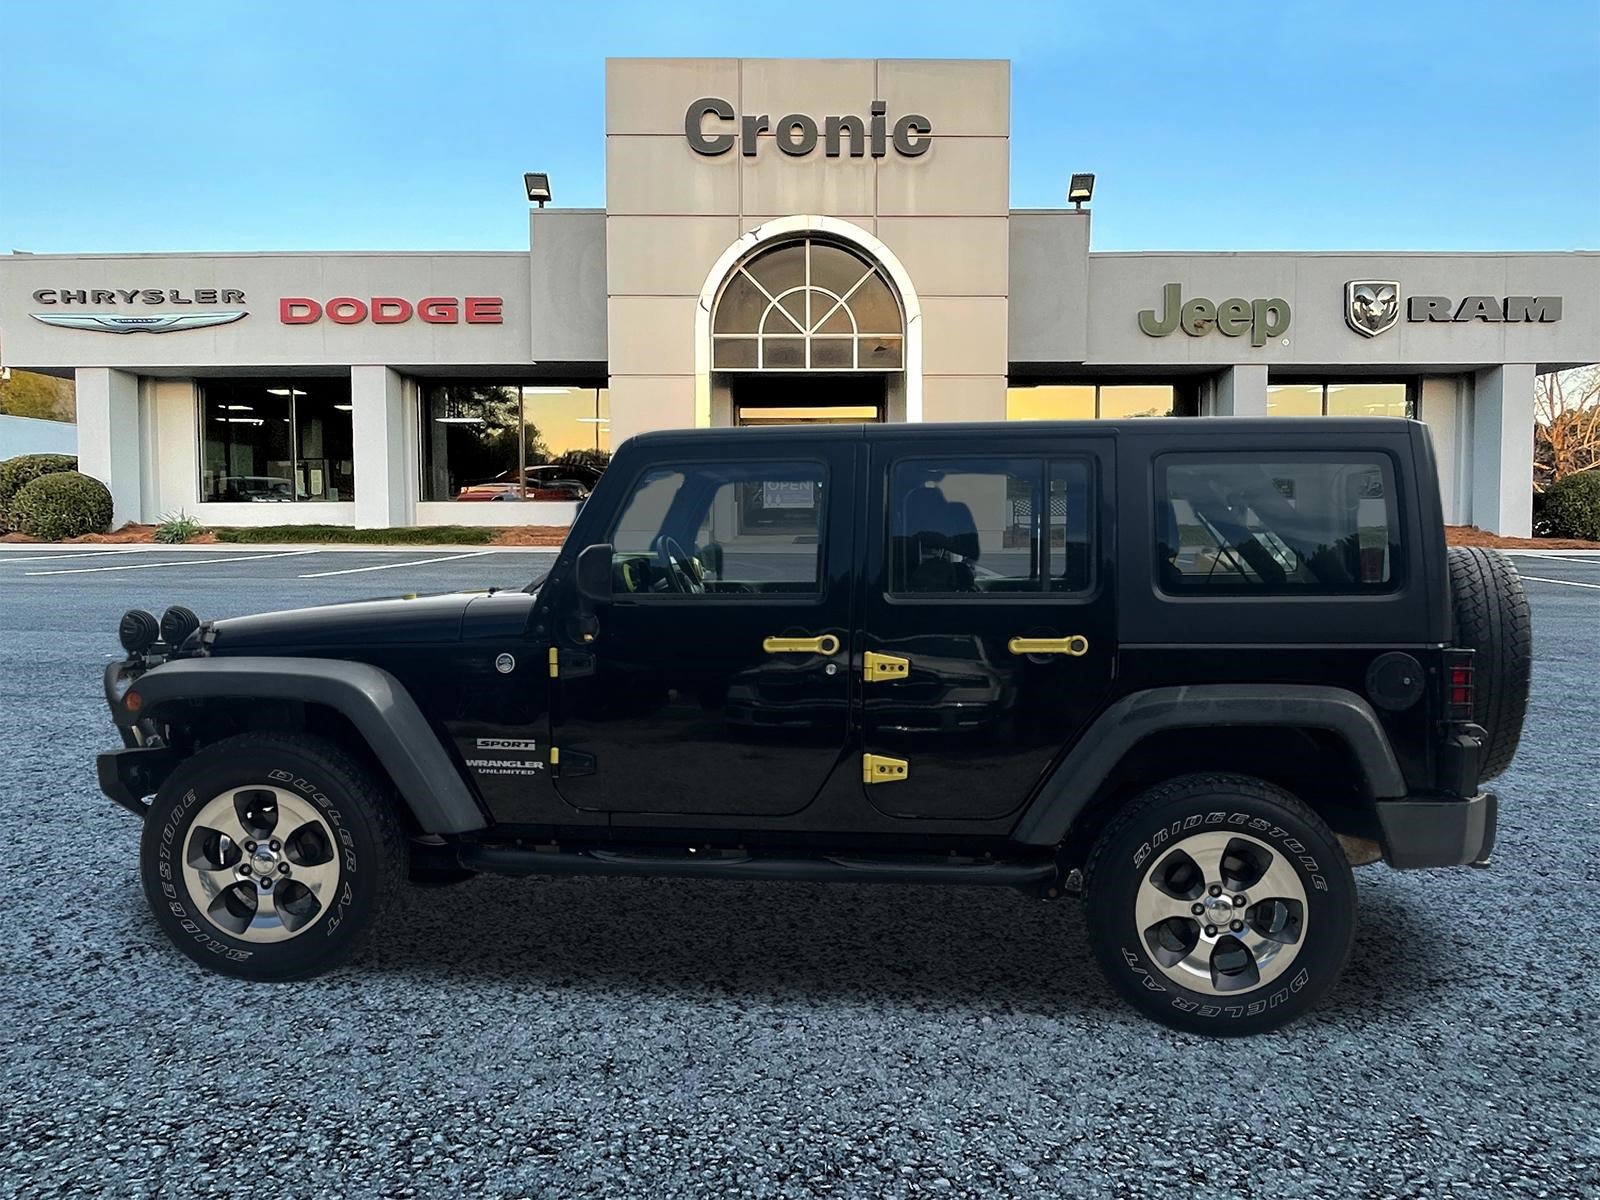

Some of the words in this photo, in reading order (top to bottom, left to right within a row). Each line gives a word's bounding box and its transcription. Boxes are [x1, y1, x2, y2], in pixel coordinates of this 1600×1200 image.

[684, 97, 932, 157] Cronic
[32, 289, 247, 305] CHRYSLER
[279, 297, 503, 325] DODGE
[1138, 283, 1292, 347] Jeep
[1407, 296, 1563, 322] RAM
[767, 481, 810, 491] OPEN
[465, 759, 544, 769] WRANGLER
[480, 740, 532, 749] SPORT
[267, 768, 357, 873] DUELER
[1133, 811, 1329, 892] BRIDGESTONE
[159, 788, 253, 962] BRIDGESTONE
[1171, 967, 1310, 1018] DUELER
